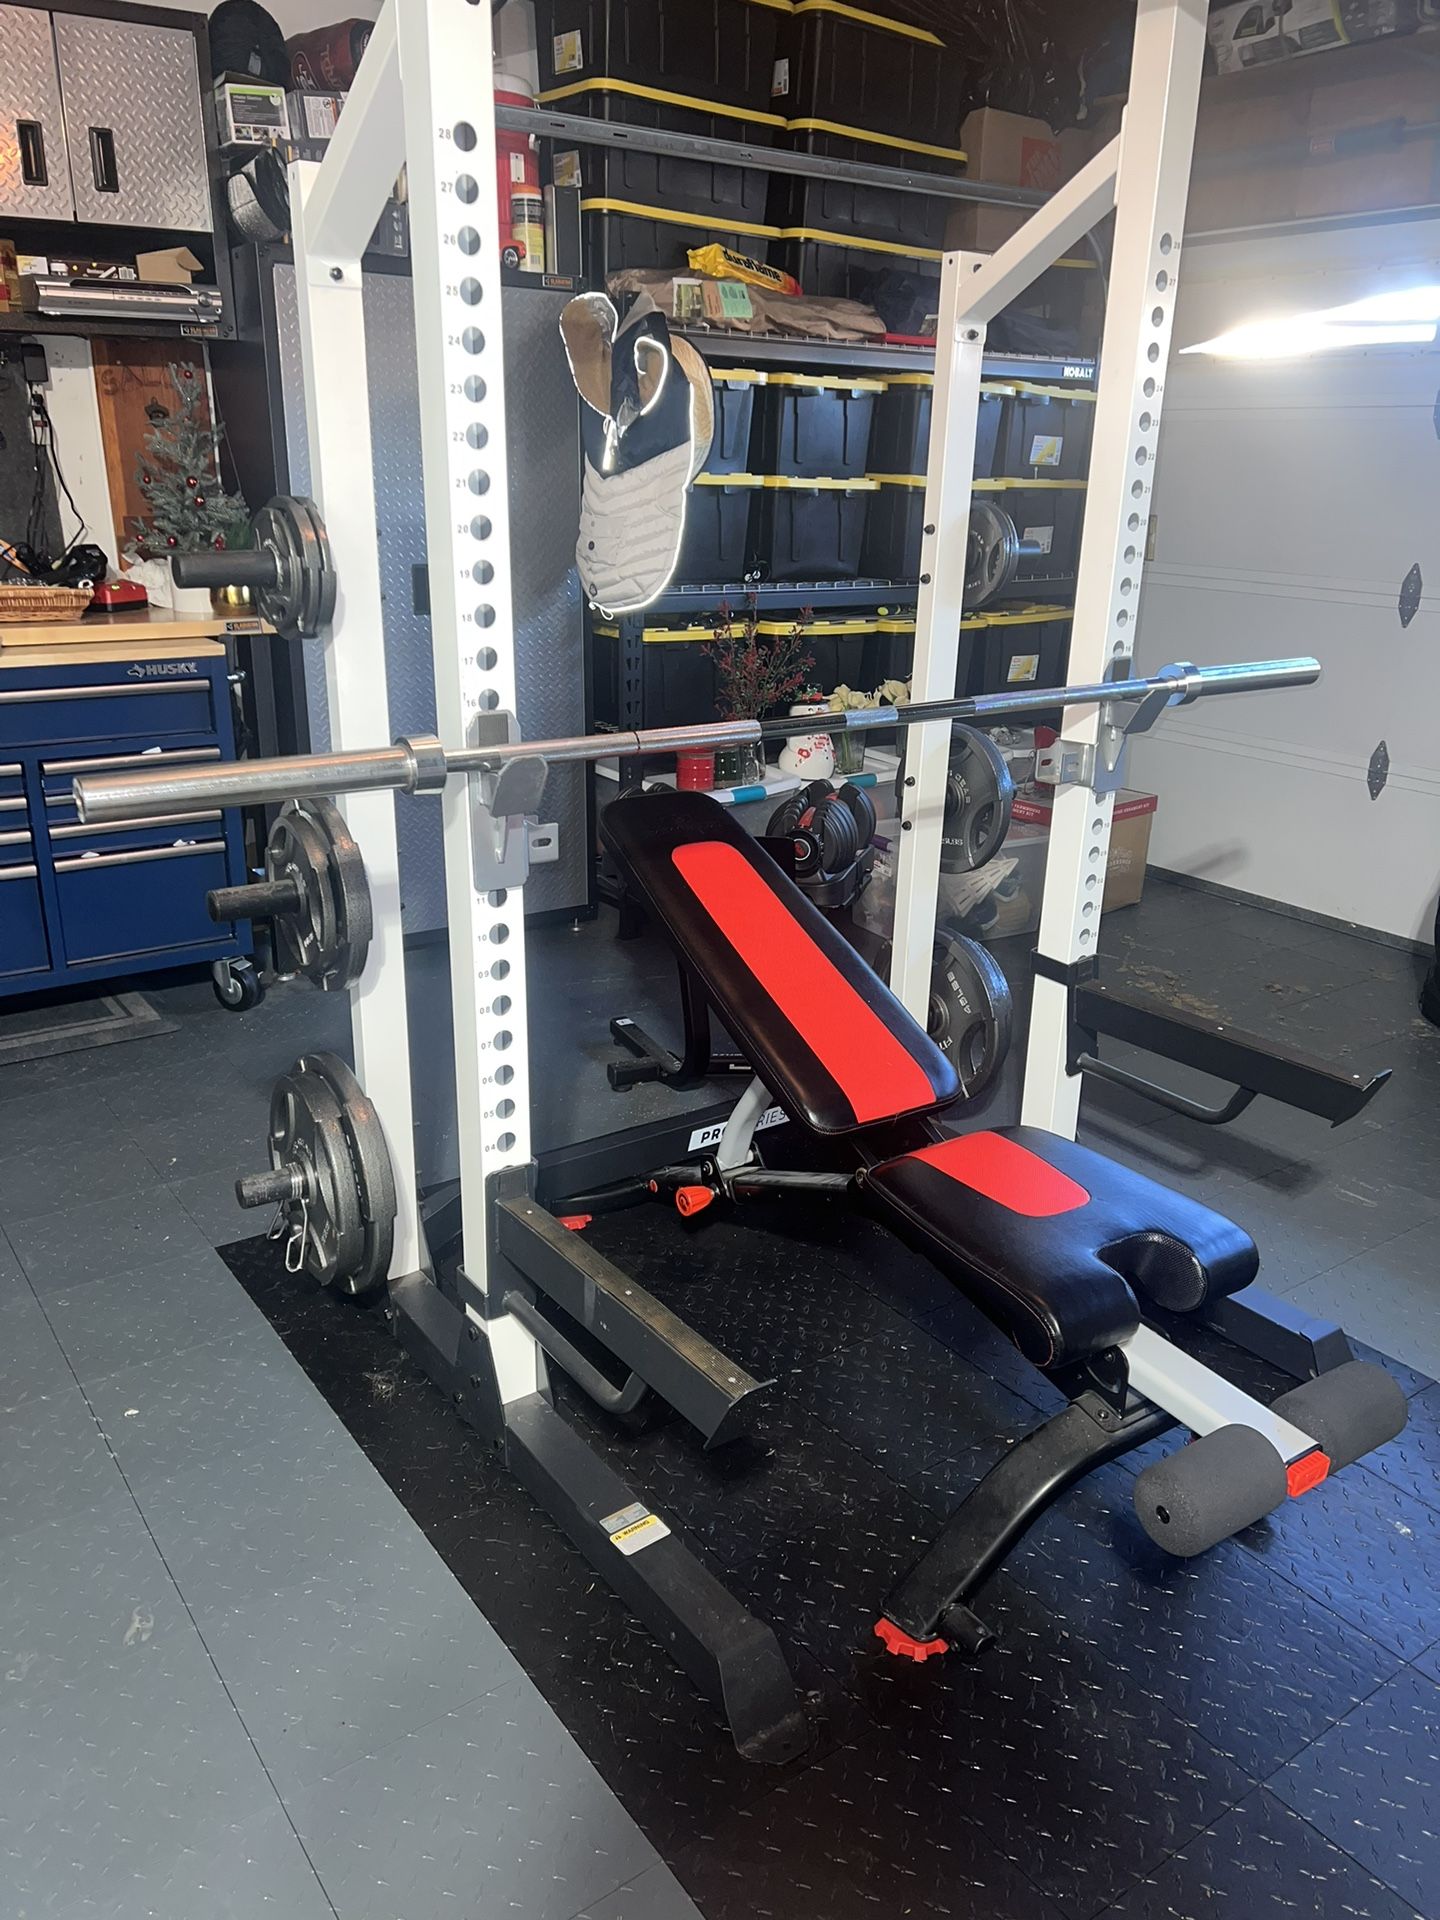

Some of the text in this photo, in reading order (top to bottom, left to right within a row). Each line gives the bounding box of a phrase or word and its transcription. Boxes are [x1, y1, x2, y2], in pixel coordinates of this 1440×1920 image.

[438, 127, 451, 140] 28
[440, 181, 453, 193] 27
[443, 233, 456, 245] 26
[722, 248, 782, 283] duraflame
[446, 285, 458, 296] 25
[448, 335, 460, 346] 24
[1063, 366, 1094, 379] KOBALT
[450, 384, 462, 394] 23
[452, 431, 465, 442] 22
[456, 478, 466, 488] 21
[457, 524, 468, 534] 20
[460, 569, 470, 579] 19
[462, 613, 472, 622] 18
[464, 656, 473, 665] 17
[145, 662, 198, 676] HUSKY
[467, 699, 476, 707] 16
[477, 897, 485, 905] 11
[478, 934, 487, 942] 10
[478, 970, 489, 979] 09
[947, 971, 972, 1015] 45LBS
[480, 1006, 490, 1014] 08
[481, 1041, 492, 1050] 07
[482, 1076, 493, 1085] 06
[484, 1110, 494, 1119] 05
[701, 1127, 726, 1144] PR
[485, 1144, 496, 1152] 04
